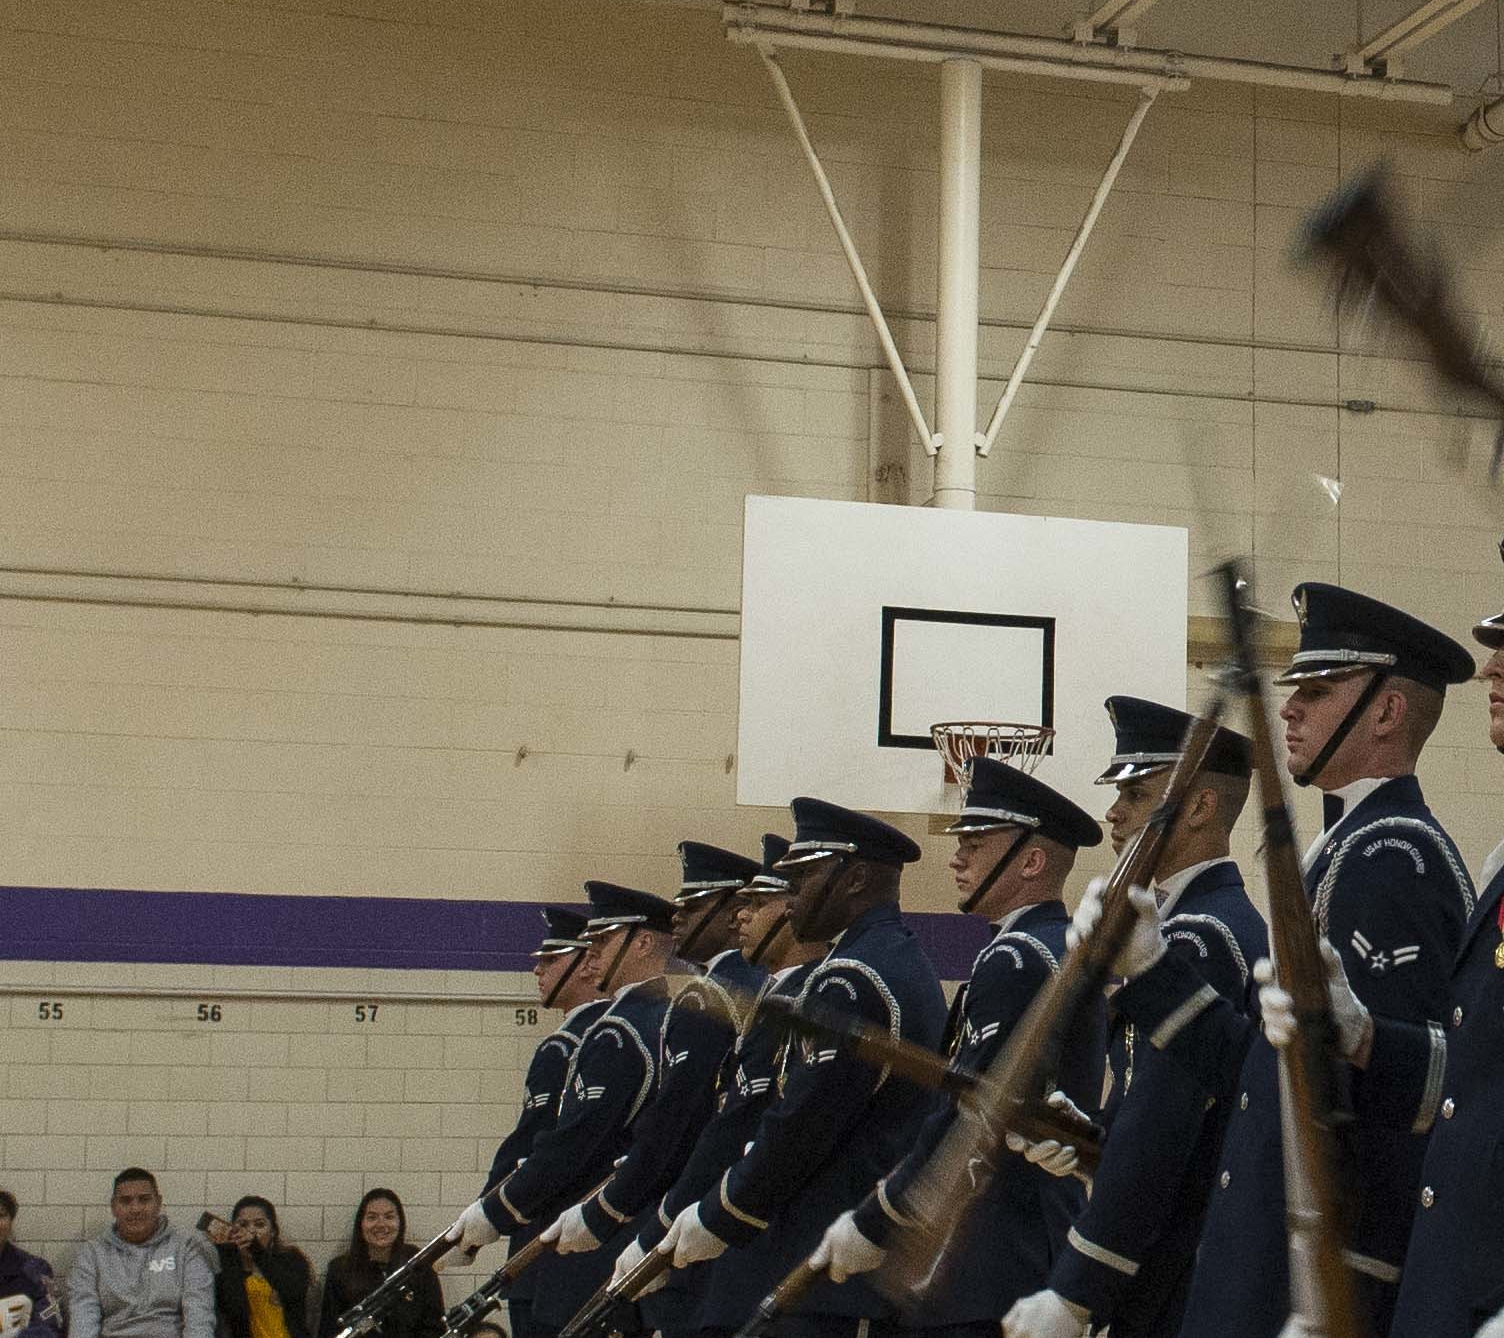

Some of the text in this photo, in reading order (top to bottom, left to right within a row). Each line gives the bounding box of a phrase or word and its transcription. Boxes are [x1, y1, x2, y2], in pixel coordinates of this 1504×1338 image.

[1361, 839, 1383, 858] USAF
[1383, 838, 1413, 852] HONOR
[37, 1002, 64, 1021] 55
[196, 1004, 222, 1022] 56
[355, 1005, 379, 1023] 57
[515, 1008, 538, 1027] 58
